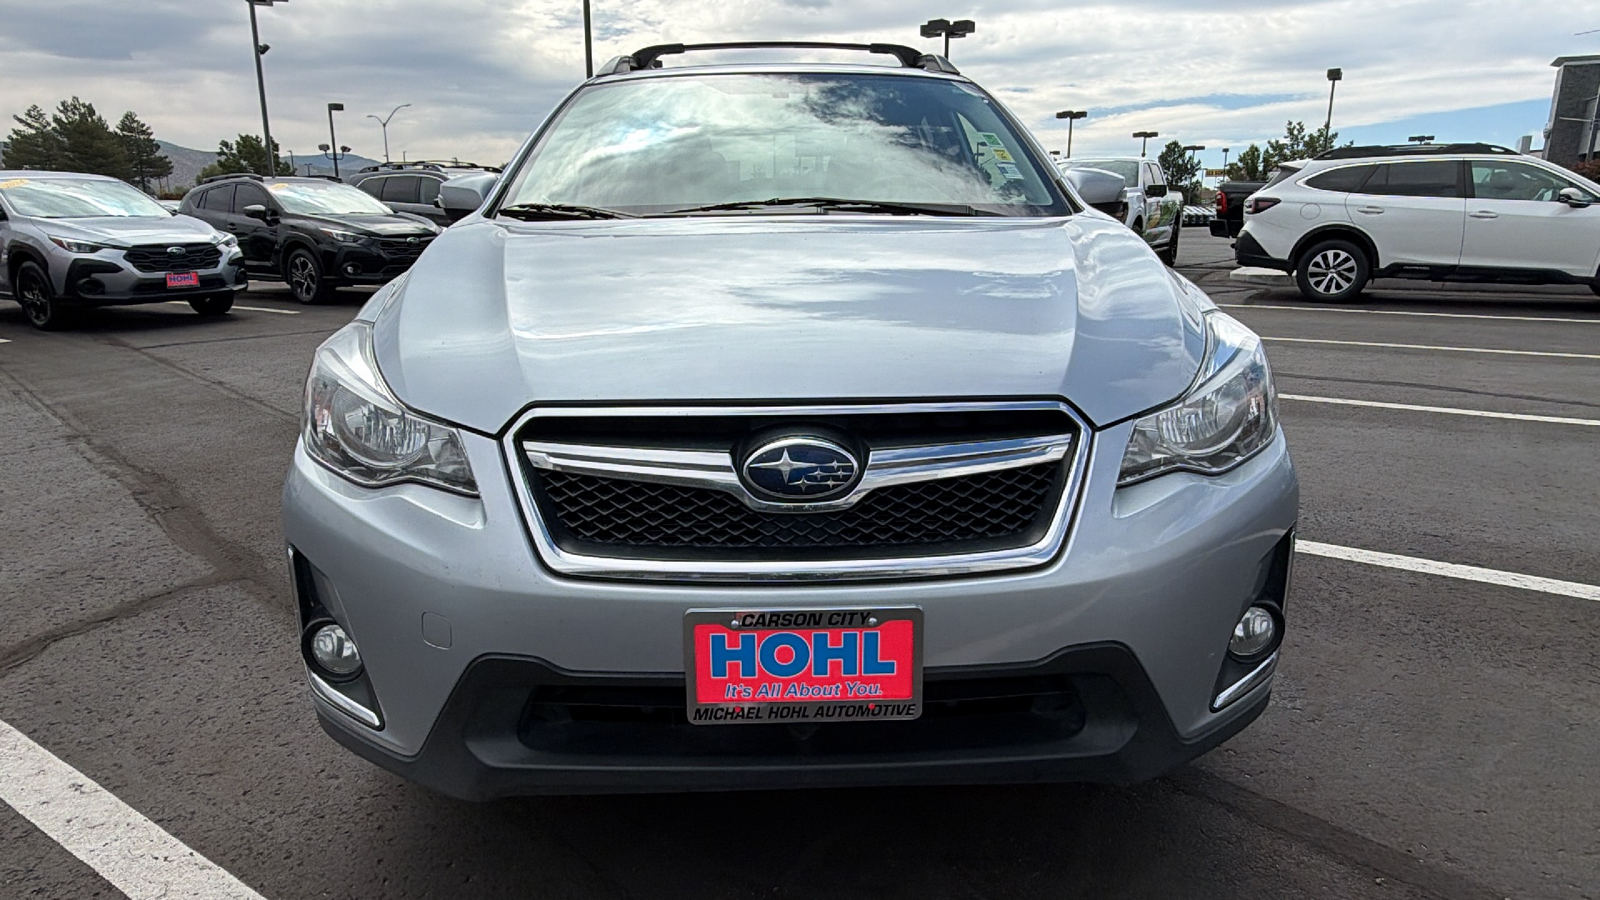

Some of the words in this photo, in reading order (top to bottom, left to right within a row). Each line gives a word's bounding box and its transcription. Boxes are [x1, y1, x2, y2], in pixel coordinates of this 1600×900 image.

[741, 612, 823, 627] CARSON
[828, 611, 870, 625] CITY
[710, 631, 897, 678] HOHL
[725, 683, 752, 698] It's
[756, 682, 781, 698] All
[785, 681, 840, 697] About
[845, 681, 882, 696] You.
[693, 706, 763, 721] MICHAEL
[767, 705, 809, 719] HOHL
[814, 703, 916, 718] AUTOMOTIVE
